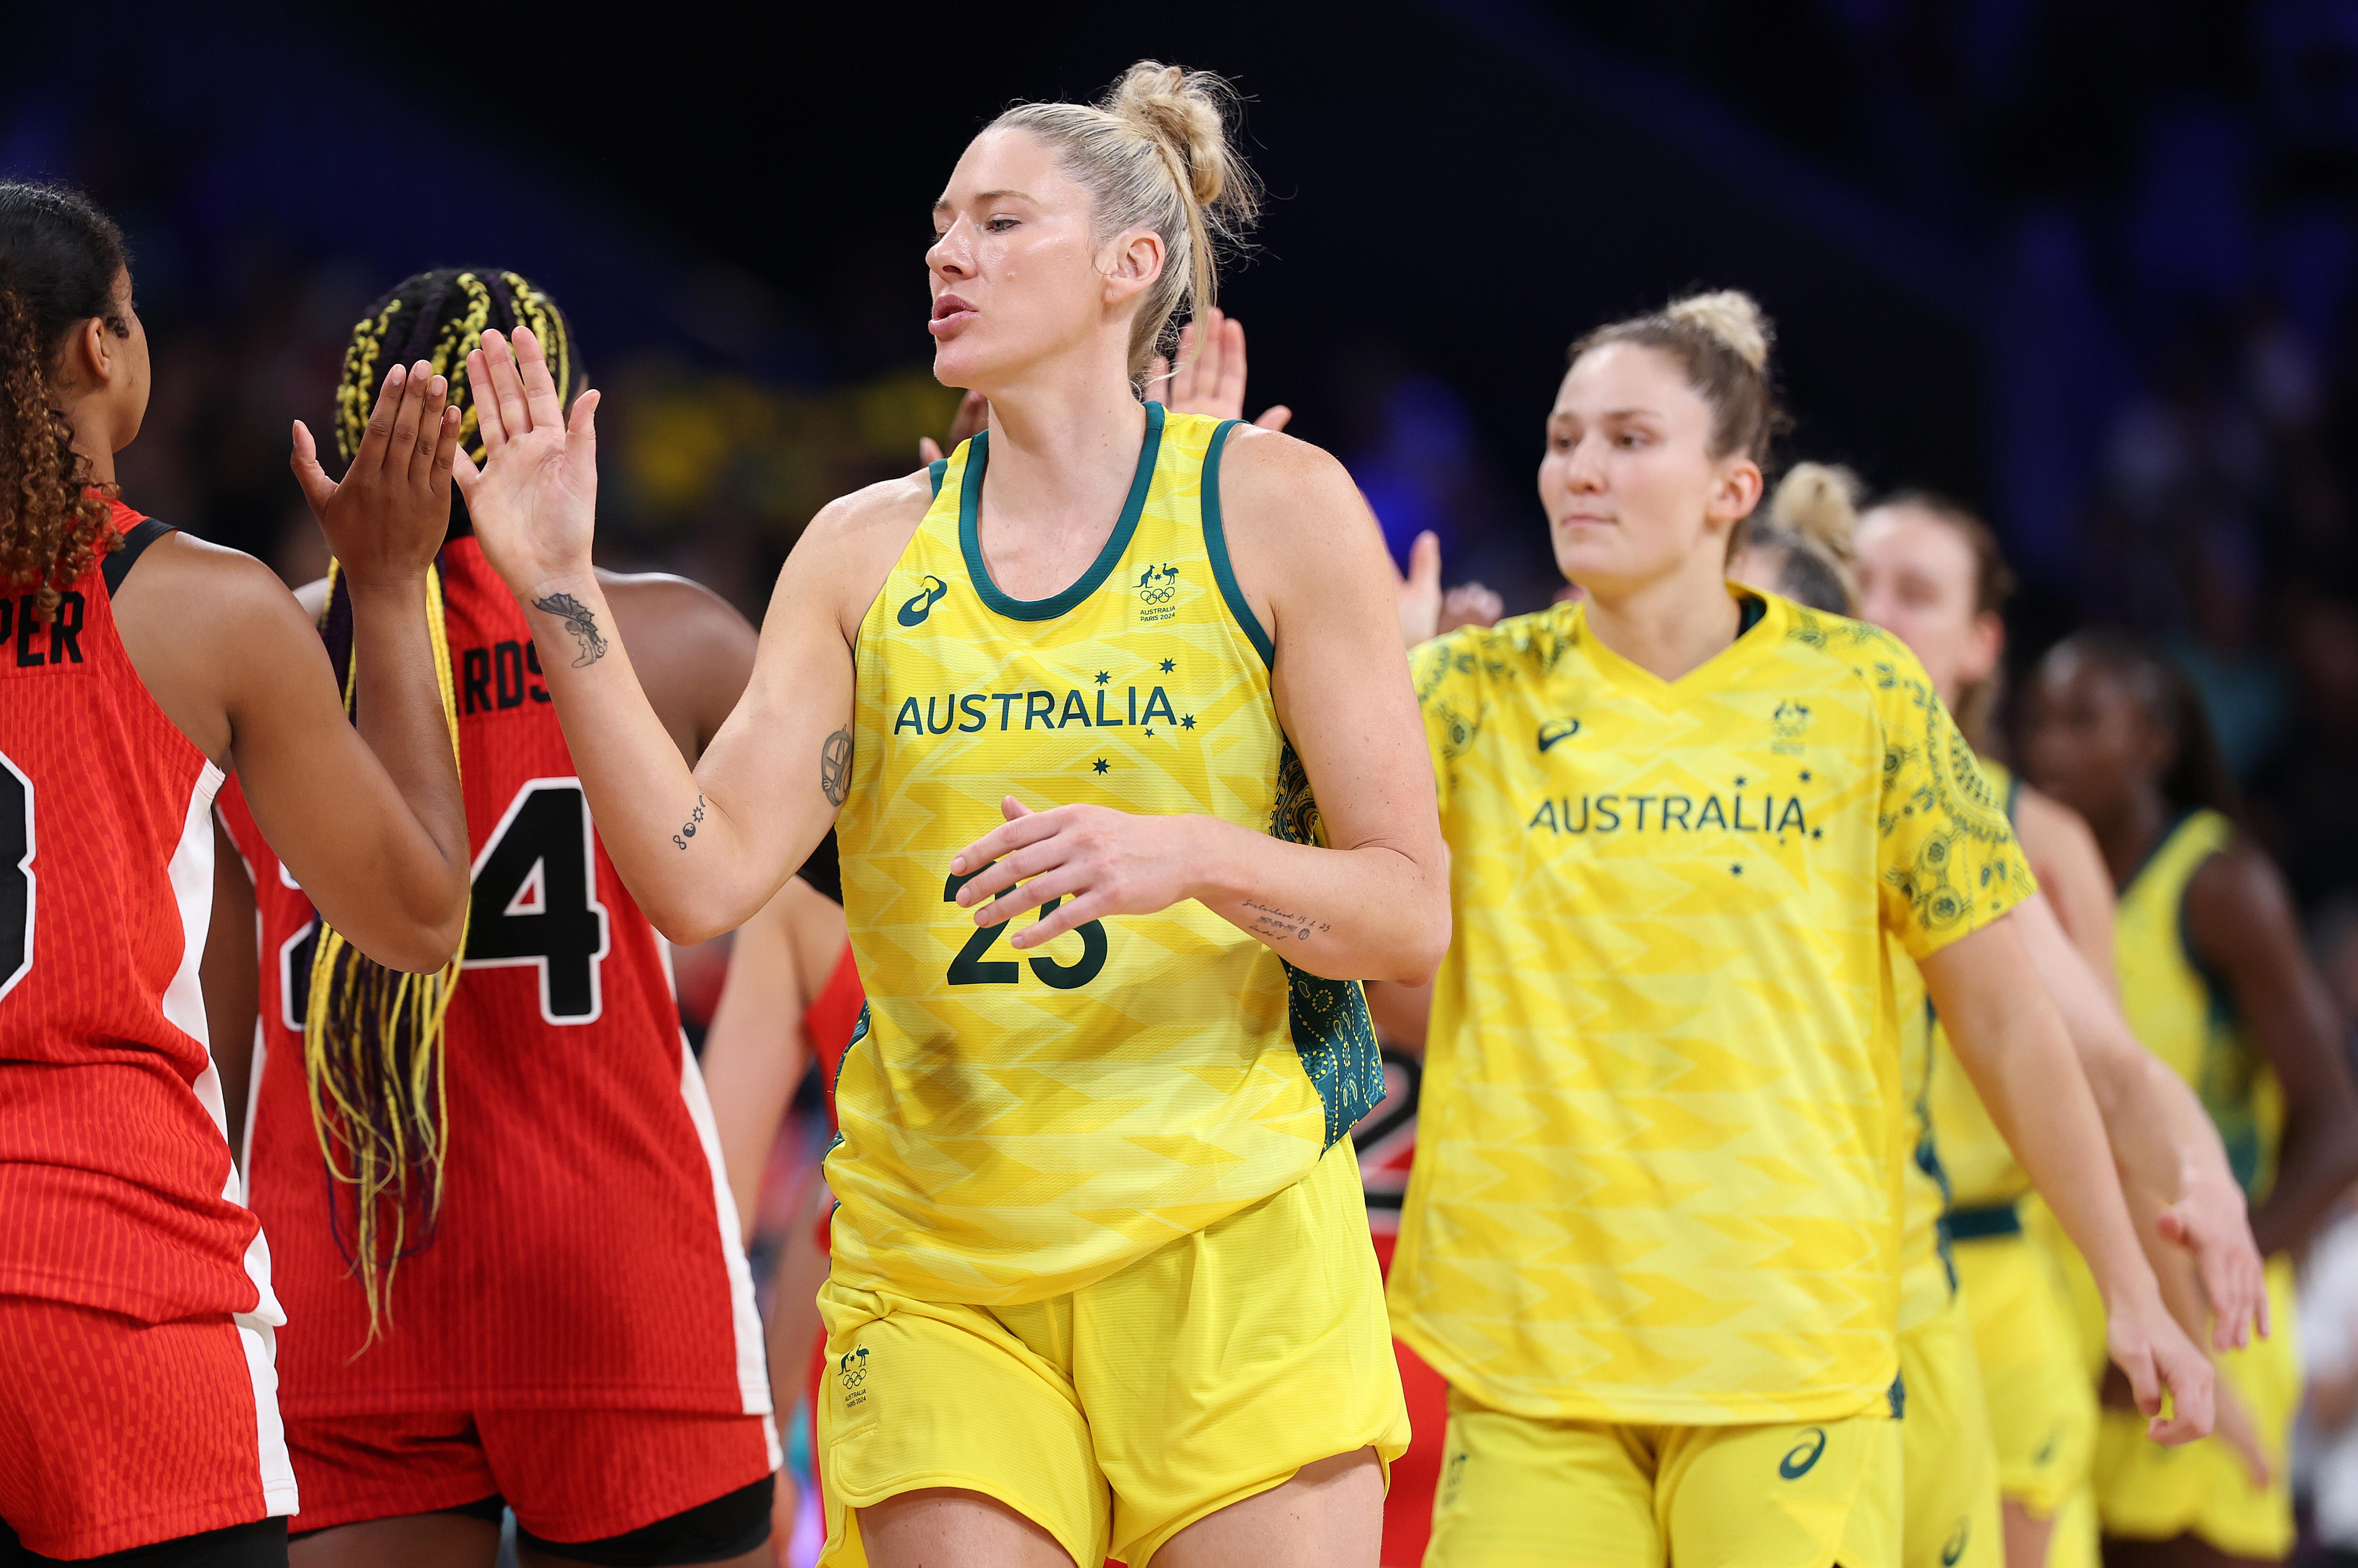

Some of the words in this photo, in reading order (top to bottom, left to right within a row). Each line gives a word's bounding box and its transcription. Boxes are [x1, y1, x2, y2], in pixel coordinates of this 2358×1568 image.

[1140, 606, 1176, 615] AUSTRALIA
[894, 686, 1177, 735] AUSTRALIA
[1528, 794, 1806, 835] AUSTRALIA
[856, 1396, 866, 1404] 2024
